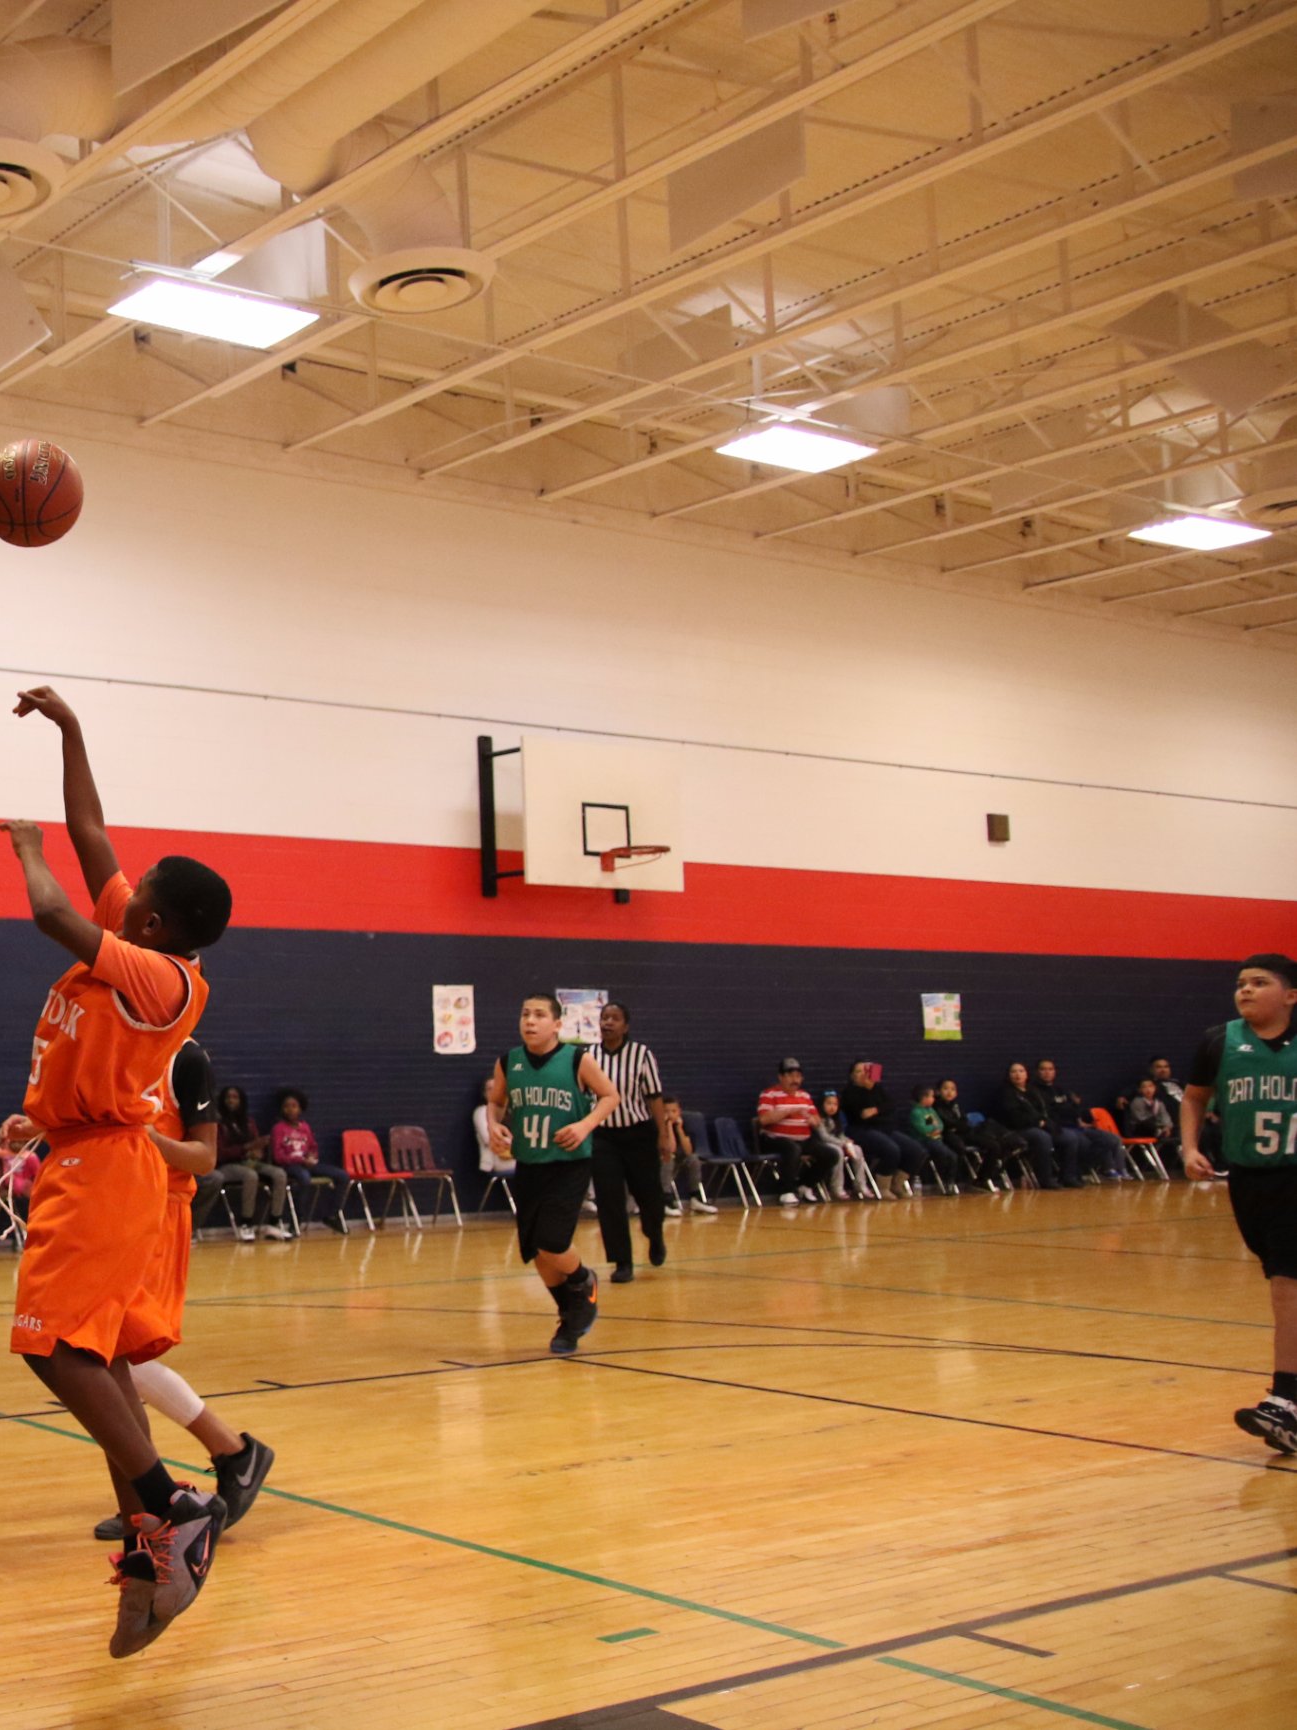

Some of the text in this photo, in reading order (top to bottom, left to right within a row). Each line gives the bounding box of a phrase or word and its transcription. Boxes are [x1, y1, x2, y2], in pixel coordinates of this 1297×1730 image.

[524, 1086, 572, 1112] HOLMES
[1227, 1076, 1254, 1104] ZAN
[523, 1114, 551, 1149] 41
